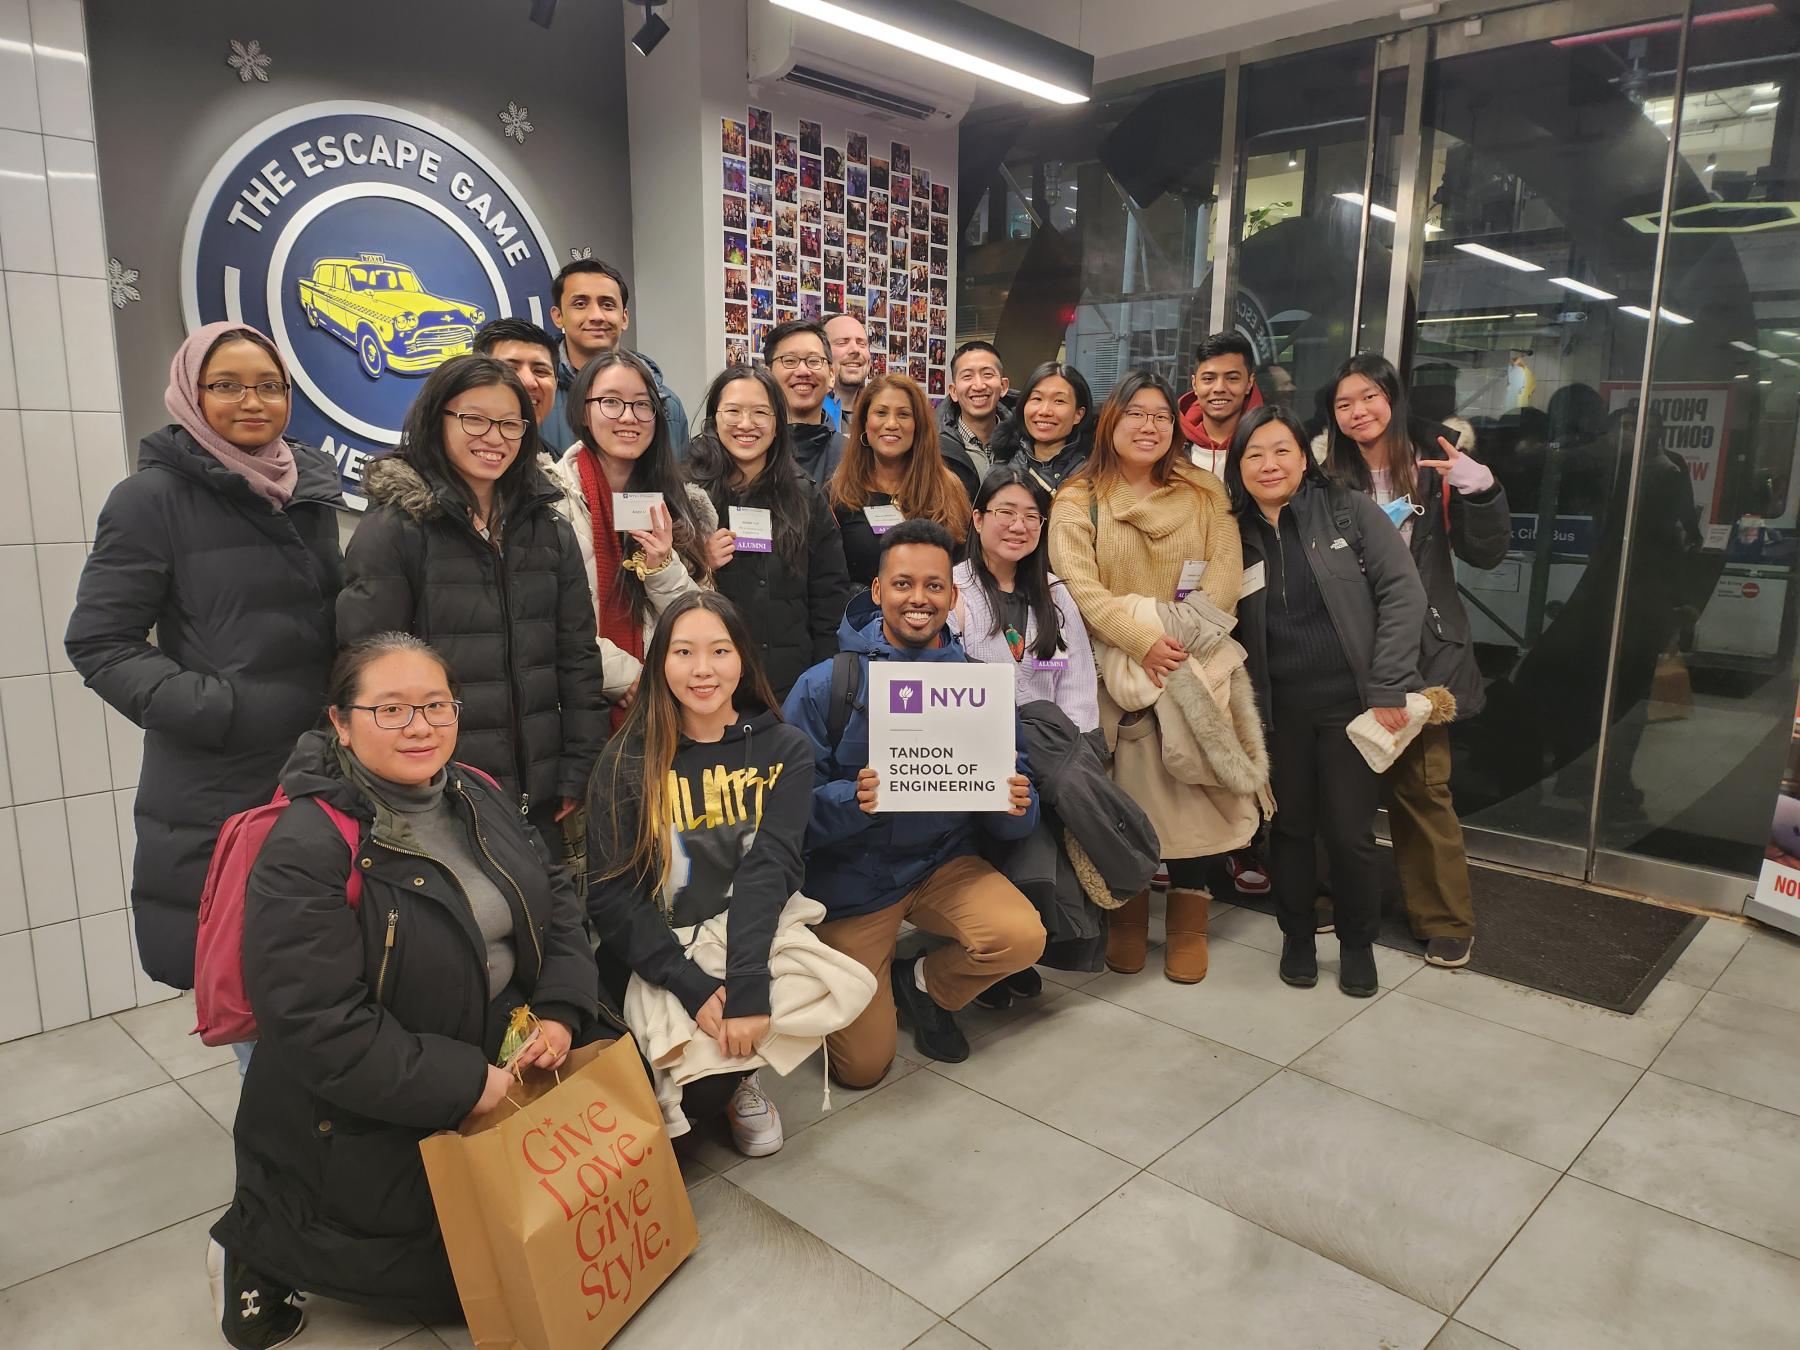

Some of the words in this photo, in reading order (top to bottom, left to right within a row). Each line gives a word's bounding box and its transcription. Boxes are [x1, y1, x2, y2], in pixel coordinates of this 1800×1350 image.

[227, 159, 296, 232] THE
[291, 132, 442, 183] ESCAPE
[450, 172, 531, 267] GAME
[320, 434, 373, 482] NE
[737, 541, 766, 550] ALUMNI
[1518, 528, 1537, 540] Cit
[930, 687, 986, 708] NYU
[889, 747, 953, 759] TANDON
[889, 763, 953, 775] SCHOOL
[957, 763, 979, 775] OF
[889, 780, 996, 792] ENGINEERING
[1774, 875, 1800, 899] NO
[522, 1101, 617, 1175] Give
[538, 1133, 653, 1221] Love.
[575, 1178, 652, 1262] Give
[580, 1221, 671, 1321] Style.
